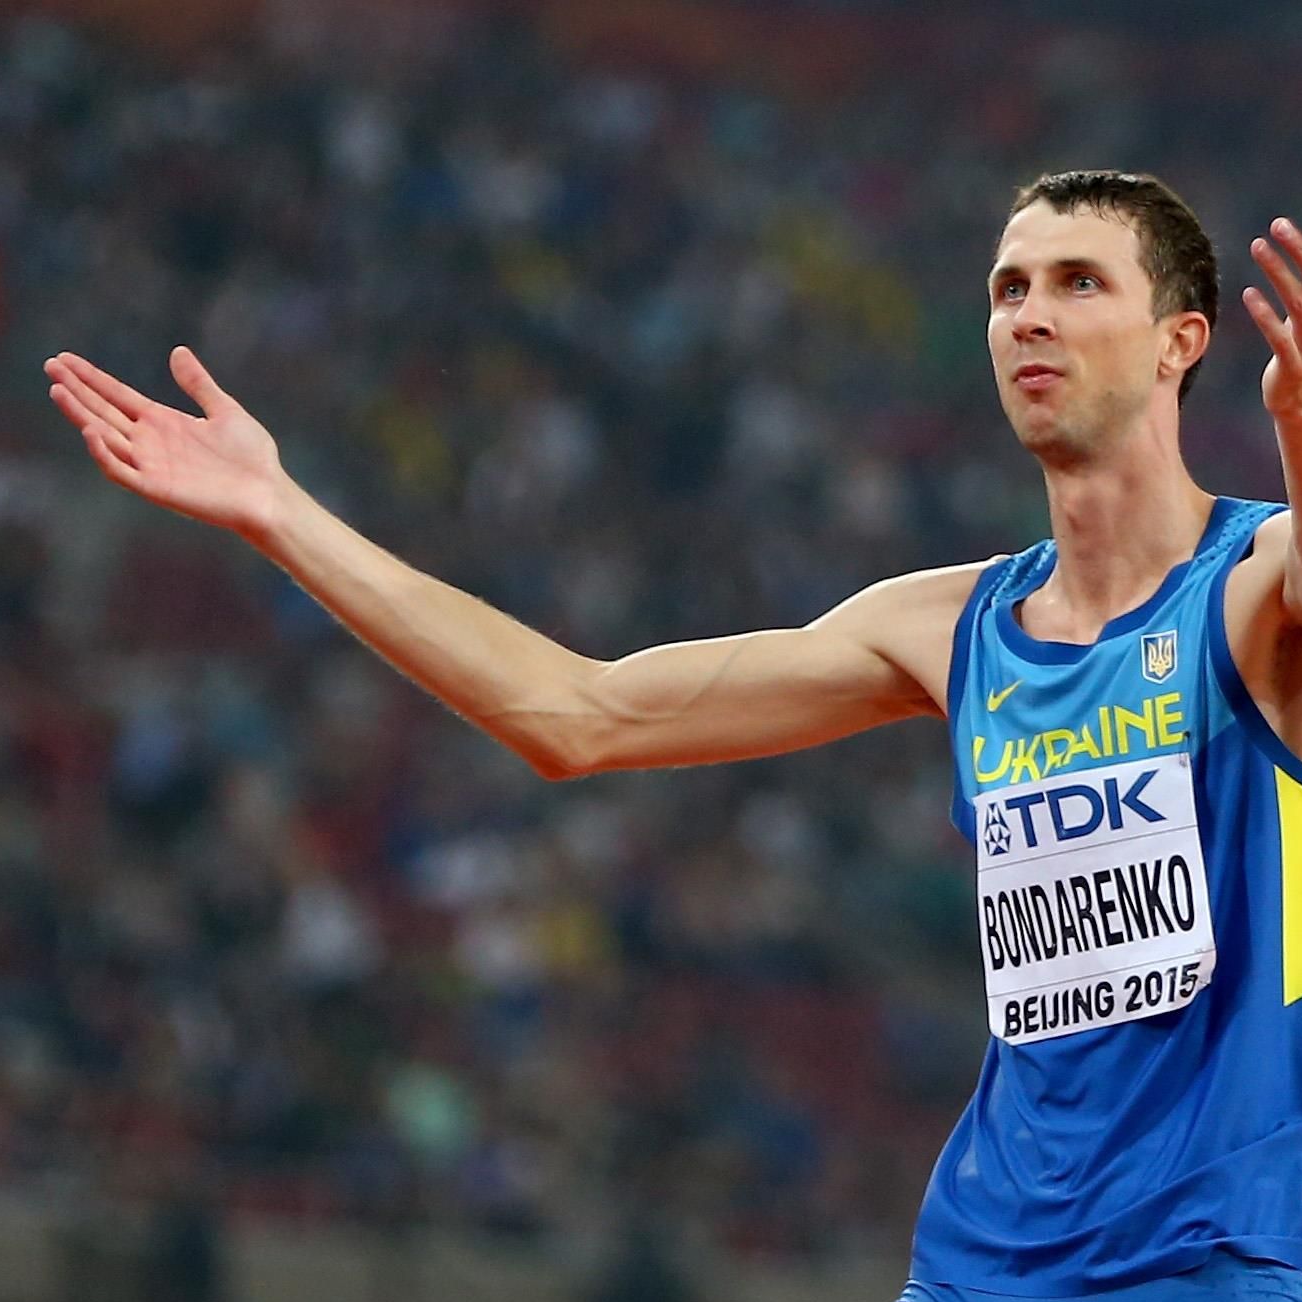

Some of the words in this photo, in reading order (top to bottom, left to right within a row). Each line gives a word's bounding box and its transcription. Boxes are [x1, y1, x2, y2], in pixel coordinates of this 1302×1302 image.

[973, 692, 1186, 784] UKRAINE
[1004, 768, 1167, 848] TDK
[984, 854, 1195, 970] BONDARENKO
[1003, 981, 1115, 1038] BEIJING
[1124, 962, 1201, 1013] 2015
